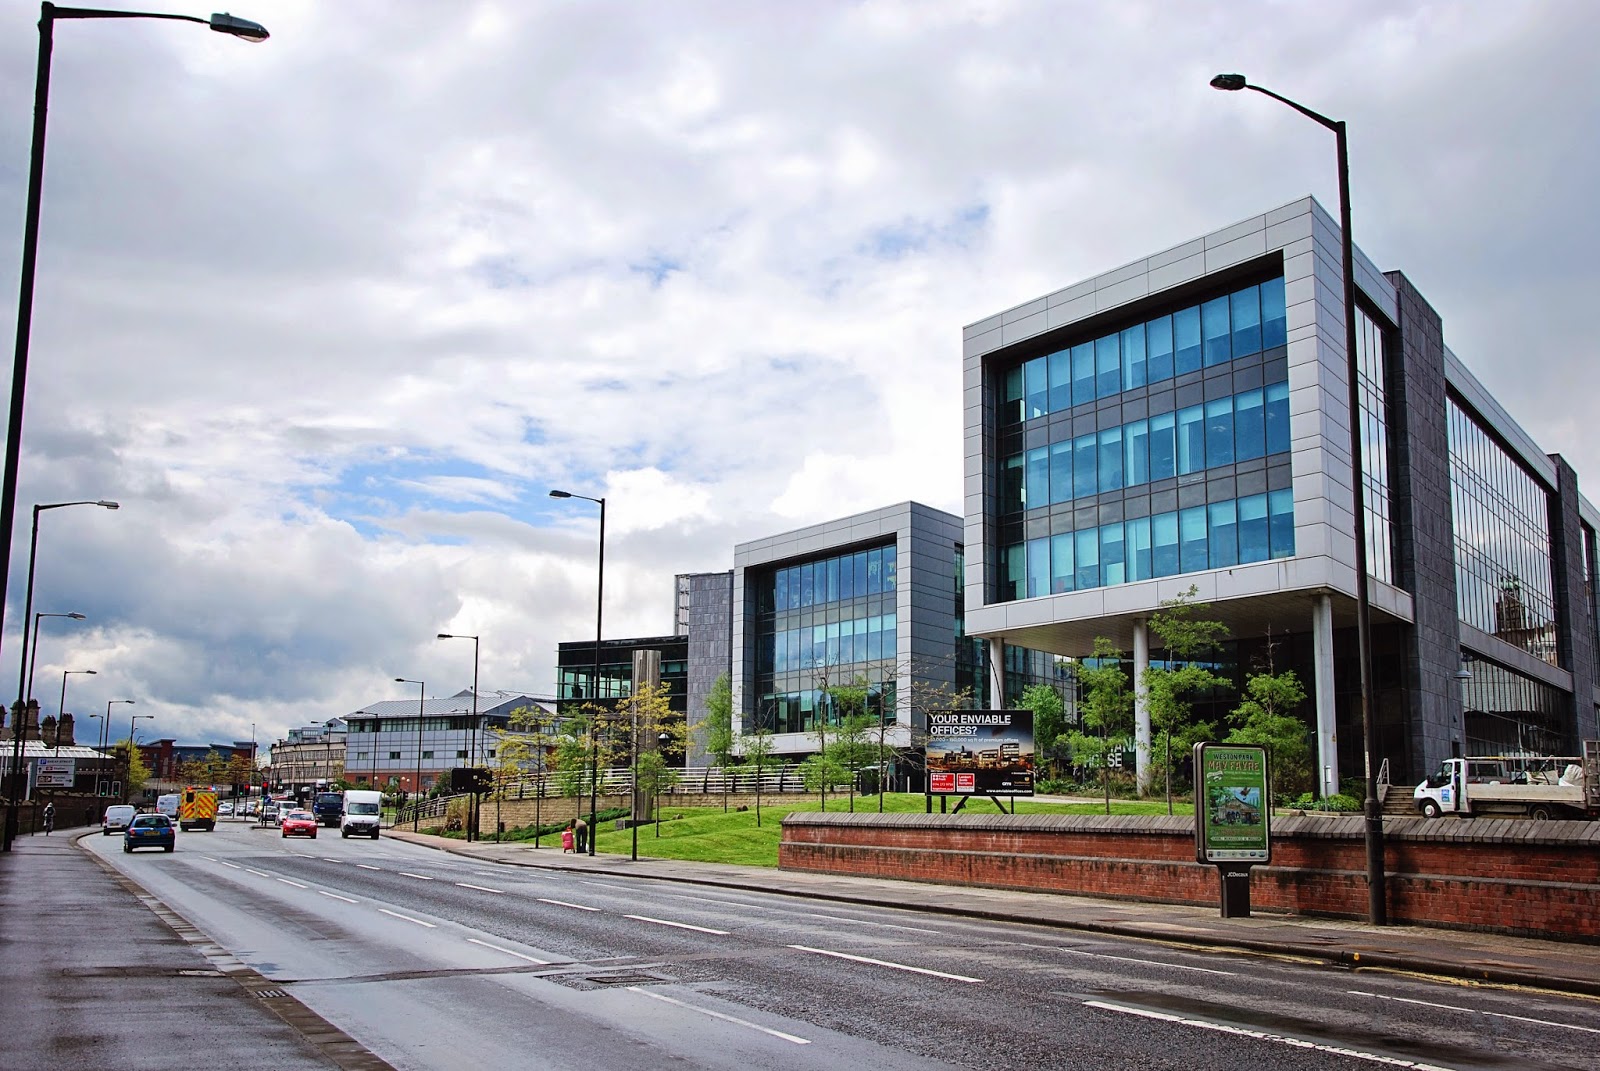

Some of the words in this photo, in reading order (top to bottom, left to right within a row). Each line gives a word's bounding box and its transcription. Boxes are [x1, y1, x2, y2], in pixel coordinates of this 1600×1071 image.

[930, 715, 958, 724] YOUR
[960, 715, 1011, 724] ENVIABLE
[930, 726, 977, 735] OFFICES?
[1208, 761, 1228, 770] MAY
[1230, 761, 1260, 771] FAYRE
